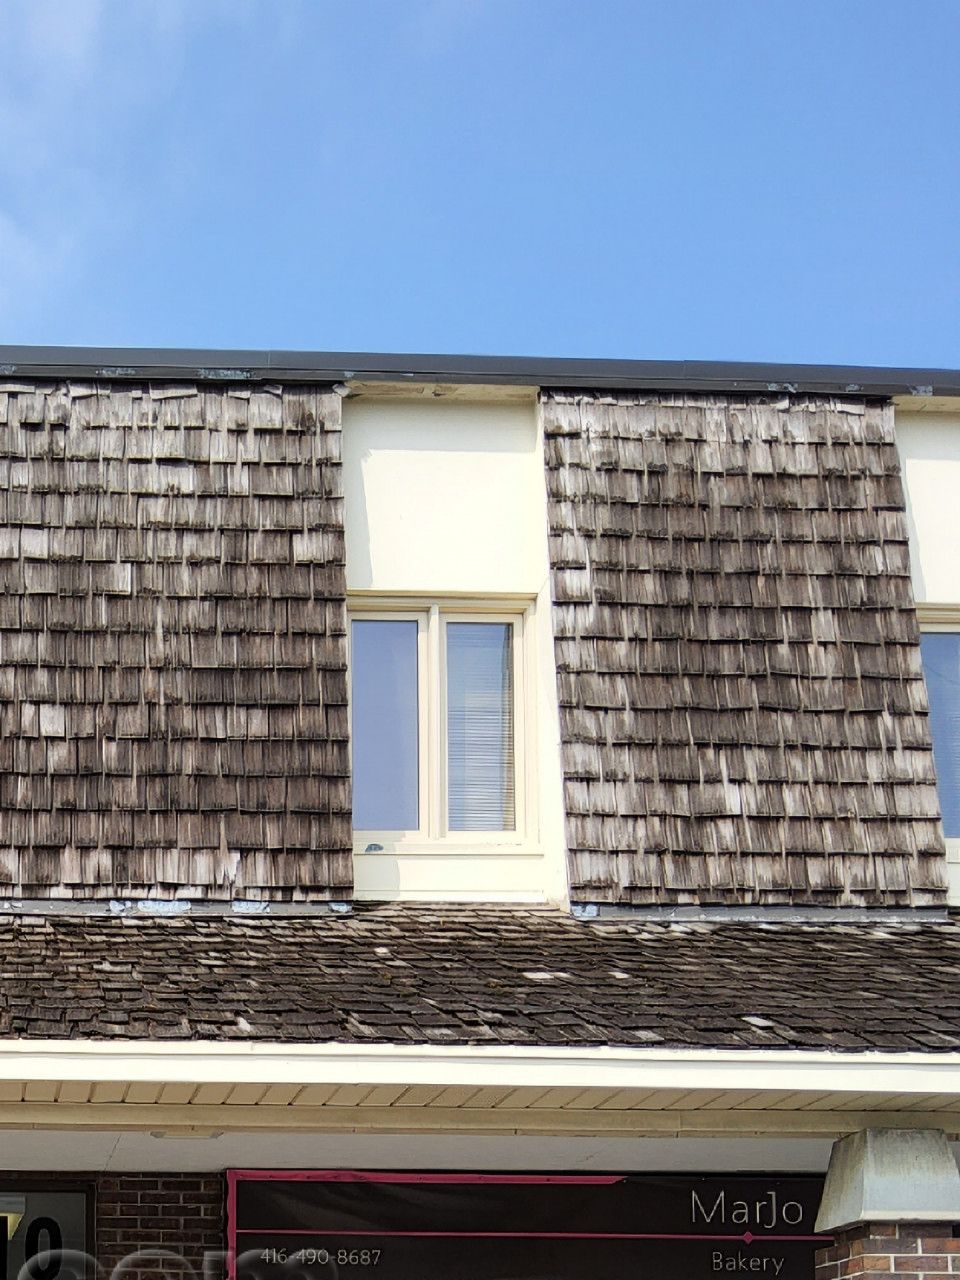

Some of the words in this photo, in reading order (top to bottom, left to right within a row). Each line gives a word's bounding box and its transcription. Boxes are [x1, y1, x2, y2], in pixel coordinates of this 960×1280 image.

[691, 1190, 803, 1228] MarJo
[260, 1248, 381, 1265] 416-490-8687
[712, 1251, 784, 1276] Bakery
